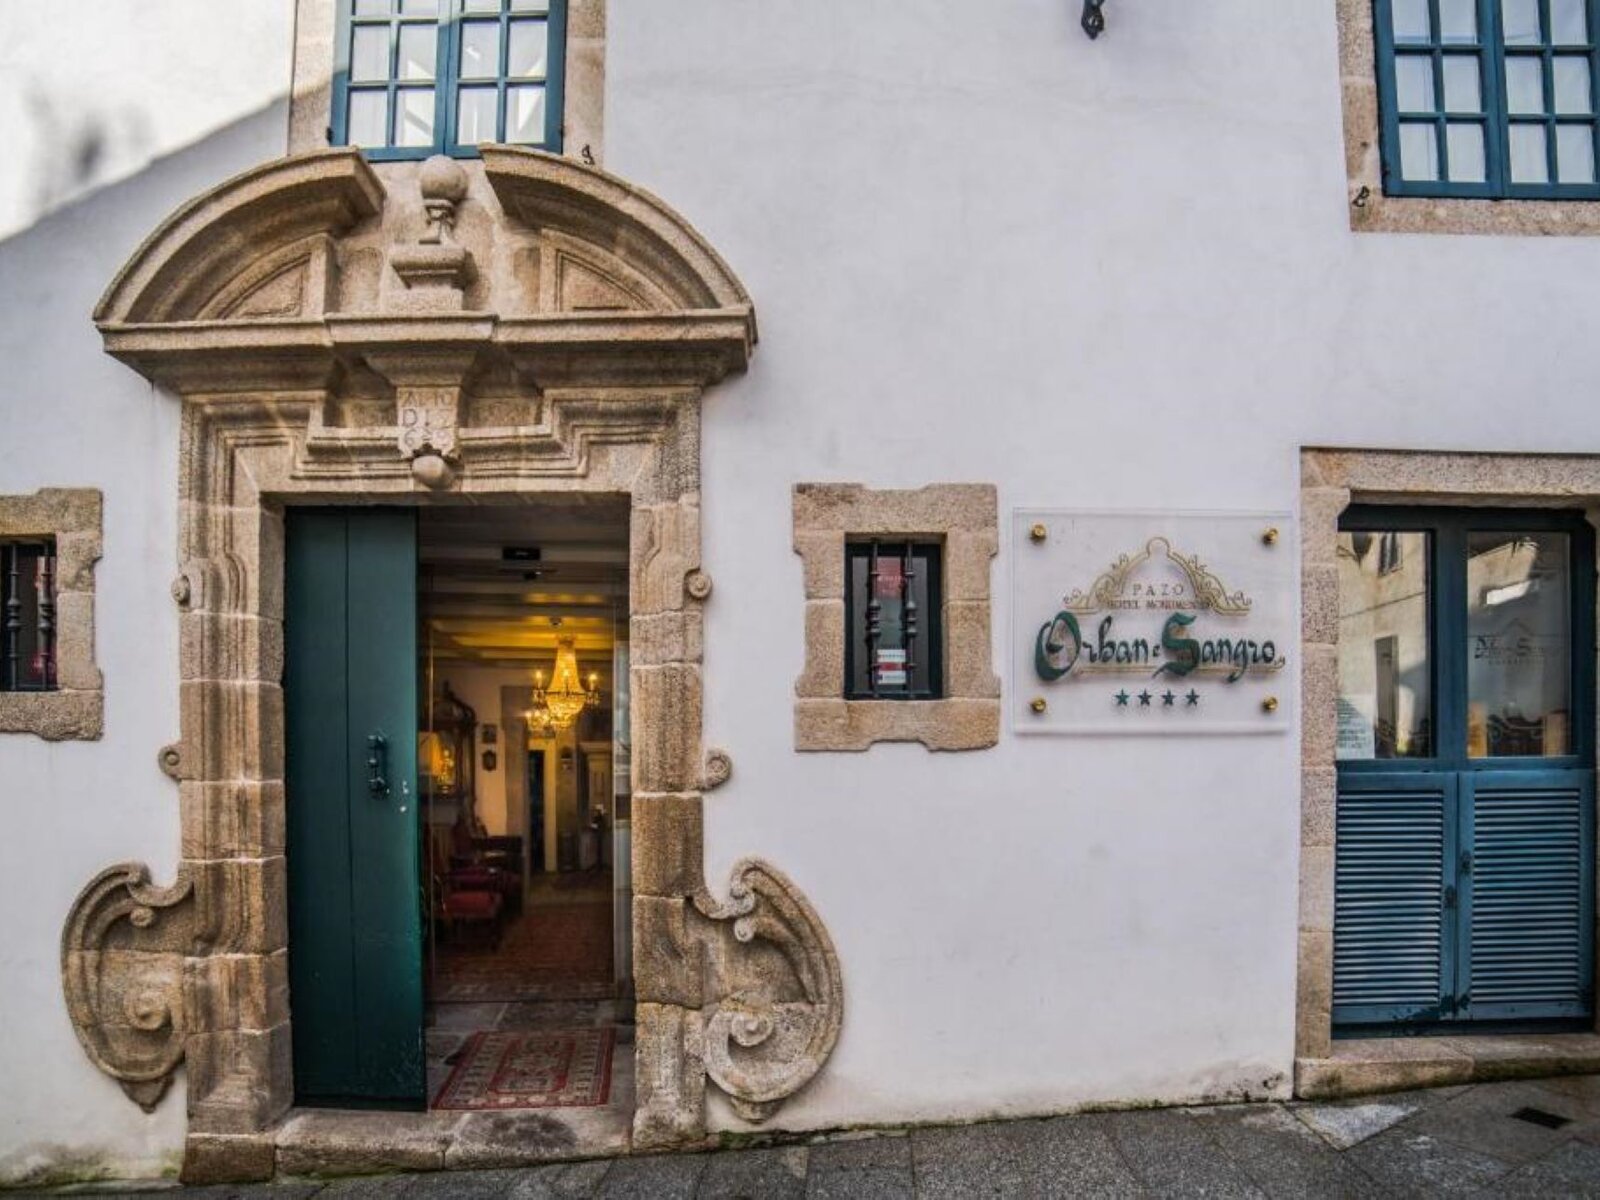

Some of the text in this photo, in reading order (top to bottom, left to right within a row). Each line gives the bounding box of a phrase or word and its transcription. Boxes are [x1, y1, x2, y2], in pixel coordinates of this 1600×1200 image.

[1132, 583, 1184, 596] PAZO
[1146, 600, 1213, 610] MONUM
[1035, 611, 1149, 681] Orban
[1152, 612, 1276, 682] Sangro
